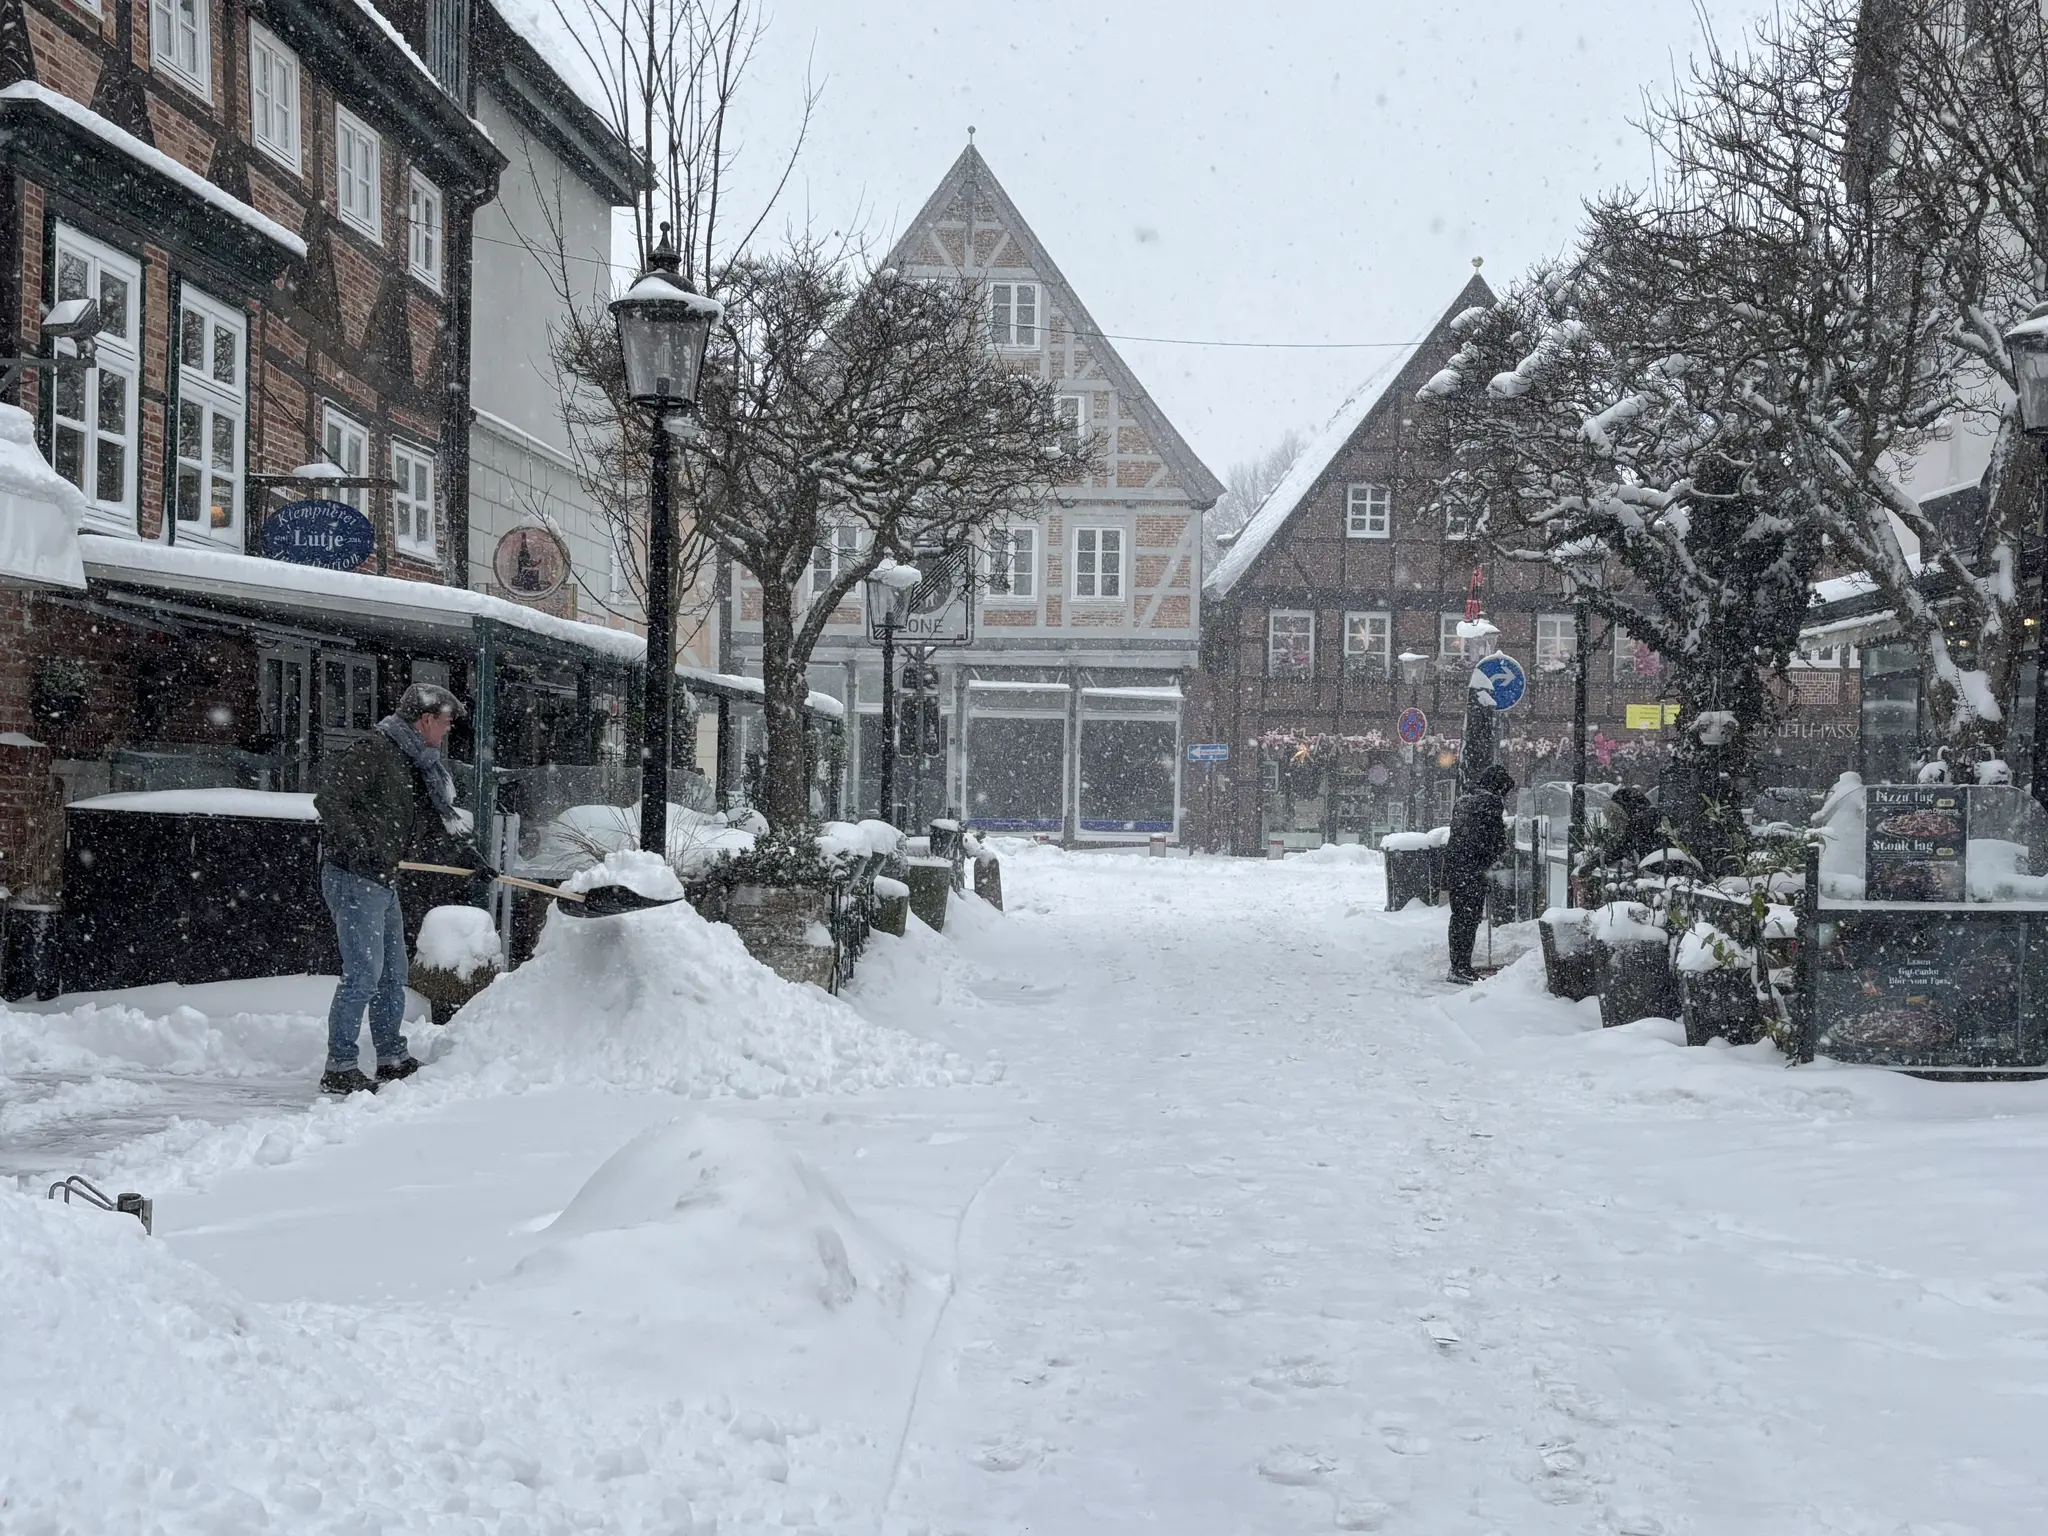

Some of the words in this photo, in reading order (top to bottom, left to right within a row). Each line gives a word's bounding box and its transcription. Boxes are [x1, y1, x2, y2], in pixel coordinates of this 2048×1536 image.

[278, 505, 357, 528] Klempnerei
[293, 529, 344, 552] Lütje
[897, 619, 943, 633] ONE
[1875, 789, 1909, 802] Pizza
[1914, 791, 1934, 804] Tag
[1872, 840, 1909, 852] Steak
[1914, 840, 1934, 853] Tag
